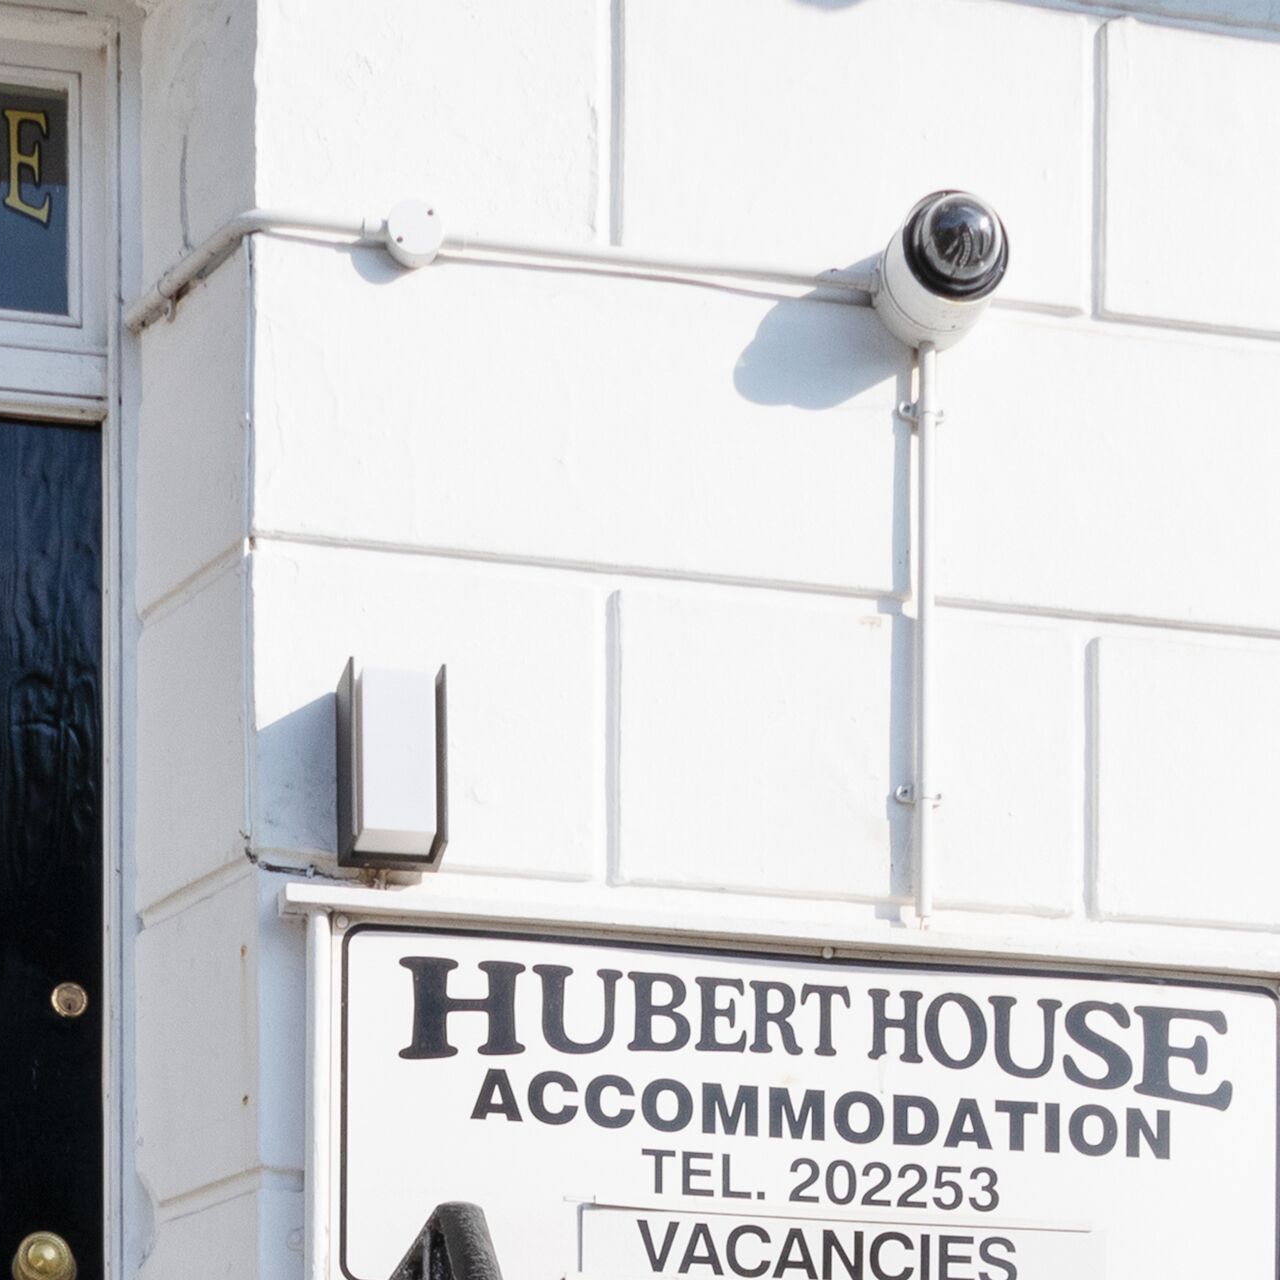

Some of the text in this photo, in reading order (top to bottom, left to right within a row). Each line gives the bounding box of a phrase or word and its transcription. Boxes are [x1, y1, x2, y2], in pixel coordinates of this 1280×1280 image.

[398, 956, 1233, 1110] HUBERT HOUSE
[470, 1068, 1171, 1159] ACCOMMODATION
[641, 1149, 1000, 1212] TEL. 202253
